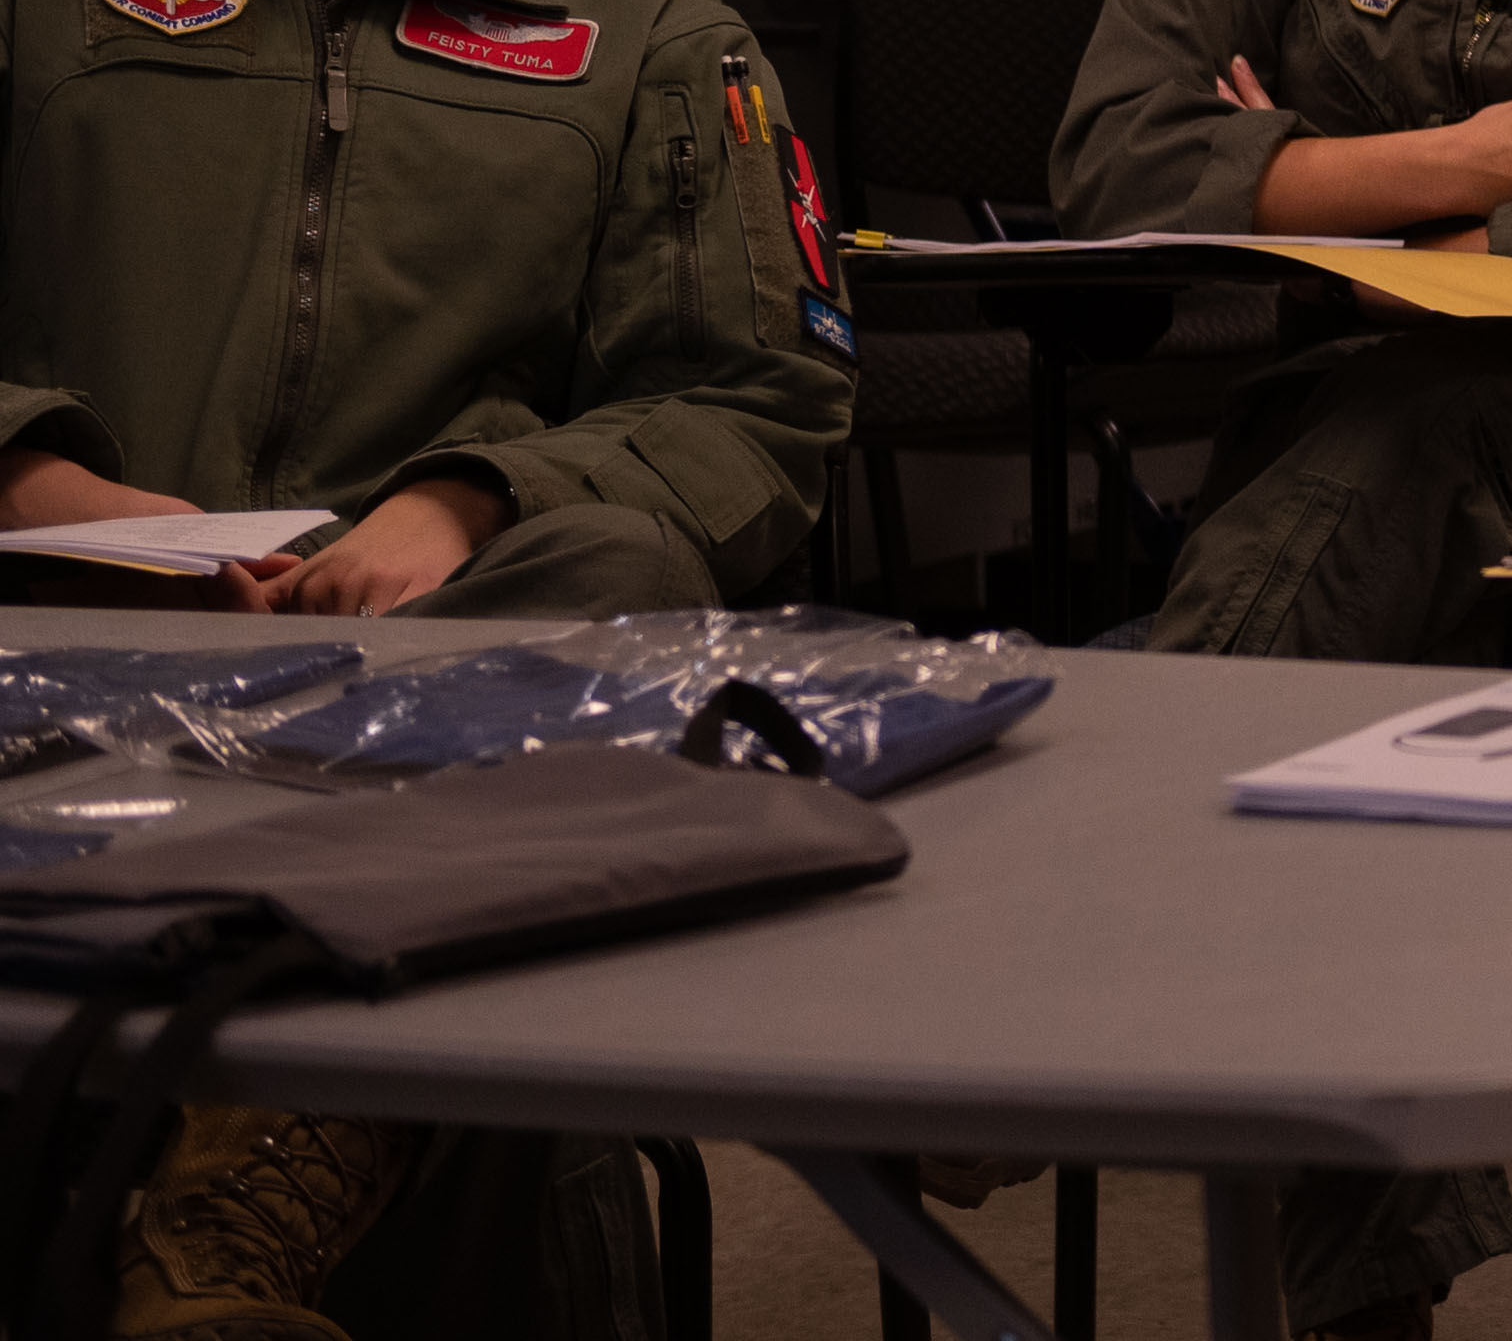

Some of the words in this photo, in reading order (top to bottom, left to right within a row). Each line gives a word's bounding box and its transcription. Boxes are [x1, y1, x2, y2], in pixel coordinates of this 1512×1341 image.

[129, 4, 179, 29] COMBAT
[181, 3, 236, 28] COMMAND
[427, 31, 493, 58] FEISTY
[502, 49, 554, 70] TUMA
